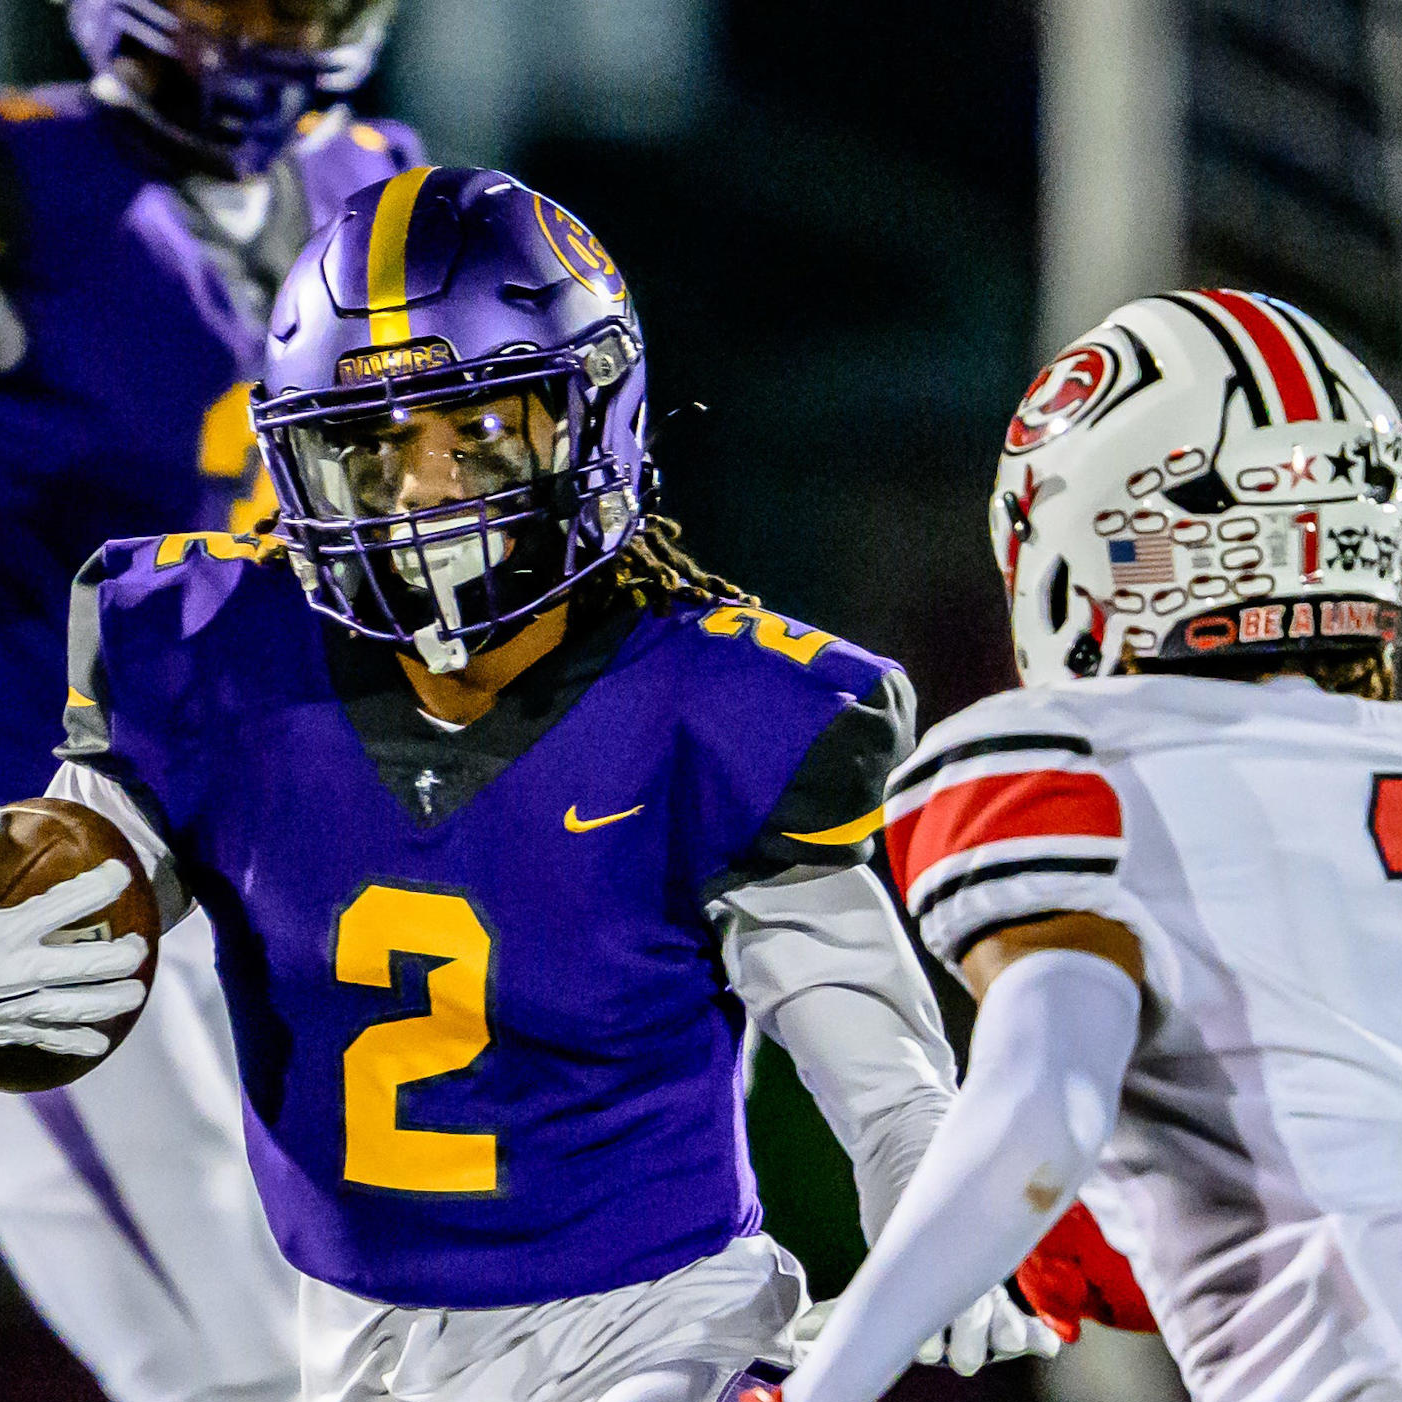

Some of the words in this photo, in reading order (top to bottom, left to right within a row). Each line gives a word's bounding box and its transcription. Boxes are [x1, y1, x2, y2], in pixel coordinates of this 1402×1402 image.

[1293, 511, 1324, 584] 1
[701, 605, 842, 667] 2
[1239, 604, 1286, 643] BE
[1289, 602, 1314, 639] A
[335, 883, 499, 1195] 2
